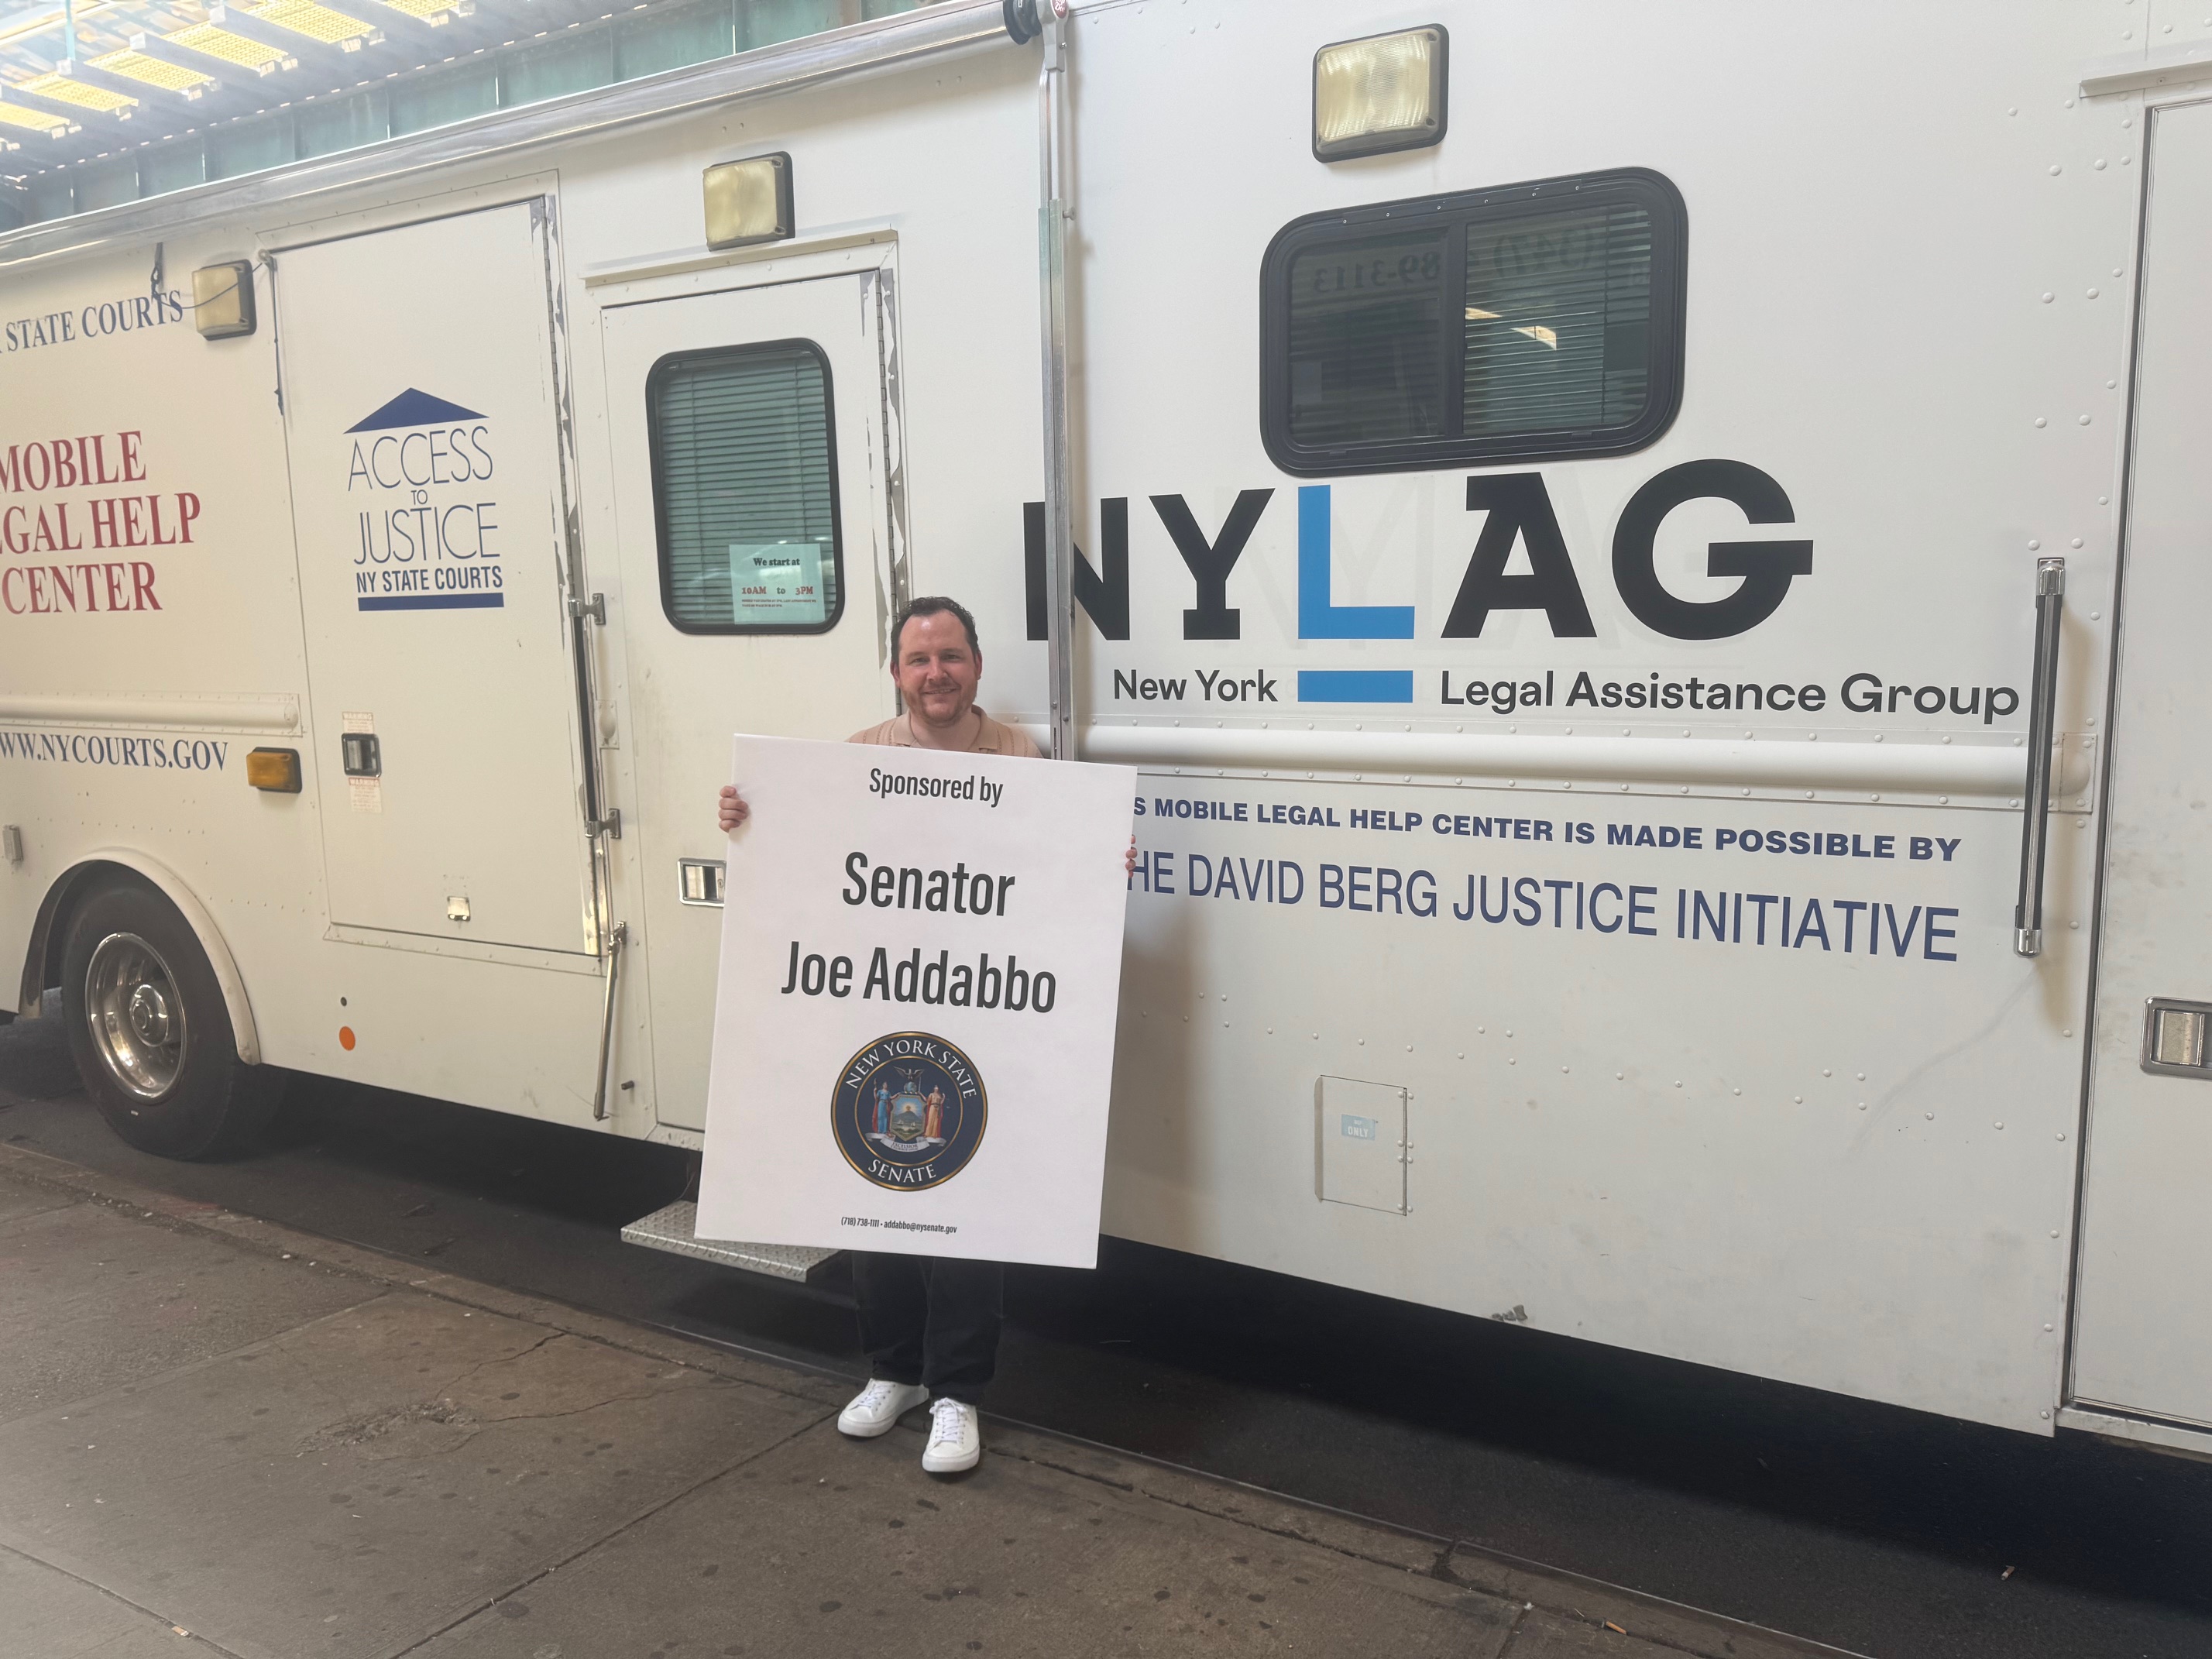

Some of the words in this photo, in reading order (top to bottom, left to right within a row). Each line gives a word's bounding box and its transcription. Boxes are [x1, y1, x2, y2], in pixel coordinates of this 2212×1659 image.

[5, 311, 75, 352] STATE
[81, 290, 184, 338] COURTS
[0, 431, 146, 493] MOBILE
[348, 425, 493, 492] ACCESS
[88, 492, 201, 549] HELP
[410, 489, 428, 506] TO
[353, 502, 500, 565] JUSTICE
[753, 558, 768, 566] We
[792, 558, 801, 566] at
[1023, 459, 1814, 641] NYLAG
[2, 562, 163, 615] CENTER
[356, 572, 376, 593] NY
[383, 569, 430, 592] STATE
[434, 565, 503, 590] COURTS
[741, 586, 767, 595] 10AM
[776, 586, 786, 595] to
[795, 586, 813, 596] 3PM
[1114, 668, 1187, 701] New
[1195, 669, 1278, 702] York
[1441, 671, 1554, 714] Legal
[1566, 672, 1826, 711] Assistance
[1840, 673, 2019, 725] Group
[869, 768, 974, 800] Sponsored
[979, 776, 1004, 808] by
[1155, 798, 1248, 822] MOBILE
[1257, 804, 1340, 827] LEGAL
[1350, 809, 1423, 832] HELP
[1432, 813, 1553, 842] CENTER
[1565, 822, 1595, 844] IS
[1606, 824, 1703, 849] MADE
[1716, 828, 1895, 859] POSSIBLE
[1909, 836, 1962, 861] BY
[843, 852, 1015, 916] Senator
[1188, 854, 1304, 905] DAVID
[1320, 864, 1437, 917] BERG
[1453, 874, 1657, 936] JUSTICE
[1677, 889, 1960, 962] INITIATIVE
[781, 941, 853, 998] Joe
[863, 946, 1056, 1013] Addabbo
[846, 1049, 881, 1089] NEW
[883, 1039, 937, 1058] YORK
[938, 1050, 977, 1098] STATE
[1348, 1126, 1369, 1138] ONLY
[867, 1159, 936, 1183] SENATE
[841, 1217, 856, 1226] (718)
[857, 1218, 879, 1228] 738-1111
[884, 1220, 957, 1235] addabbo@nysenate.gov
